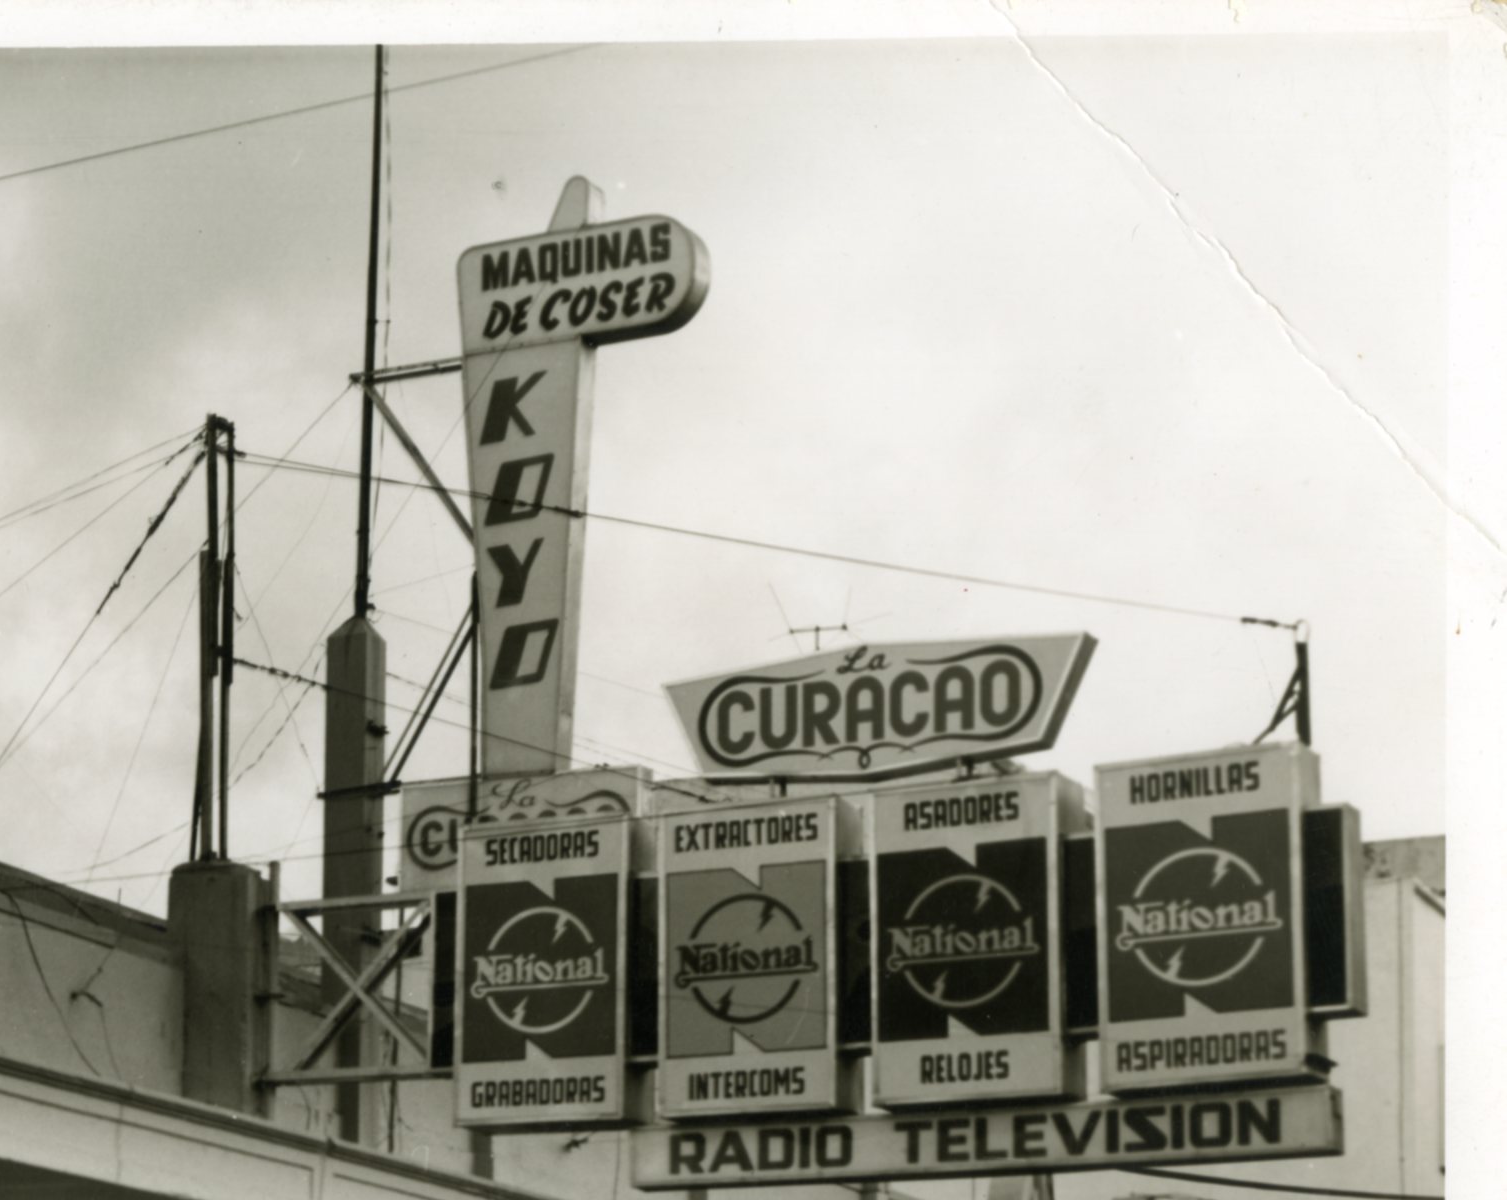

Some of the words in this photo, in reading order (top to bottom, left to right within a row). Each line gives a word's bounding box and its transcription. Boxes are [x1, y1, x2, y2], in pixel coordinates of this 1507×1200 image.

[480, 222, 672, 292] MAQUINAS
[482, 295, 530, 340] DE
[539, 271, 677, 332] COSER
[478, 368, 560, 691] KOYO
[835, 645, 891, 676] La
[716, 658, 1023, 755] CURACAO
[490, 778, 536, 812] La
[1129, 760, 1261, 805] HORNILLAS
[673, 812, 819, 854] EXTRACTORES
[903, 791, 1020, 832] ASADORES
[484, 829, 600, 868] SECADORAS
[1114, 890, 1283, 952] National
[674, 936, 819, 990] National
[886, 917, 1040, 973] National
[470, 947, 609, 999] National
[919, 1049, 1010, 1085] RELOJES
[1116, 1028, 1287, 1074] ASPIRADORAS
[470, 1075, 606, 1108] GRABADORAS
[688, 1066, 806, 1103] INTERCOMS
[668, 1125, 853, 1176] RADIO
[895, 1099, 1282, 1165] TELEVISION
